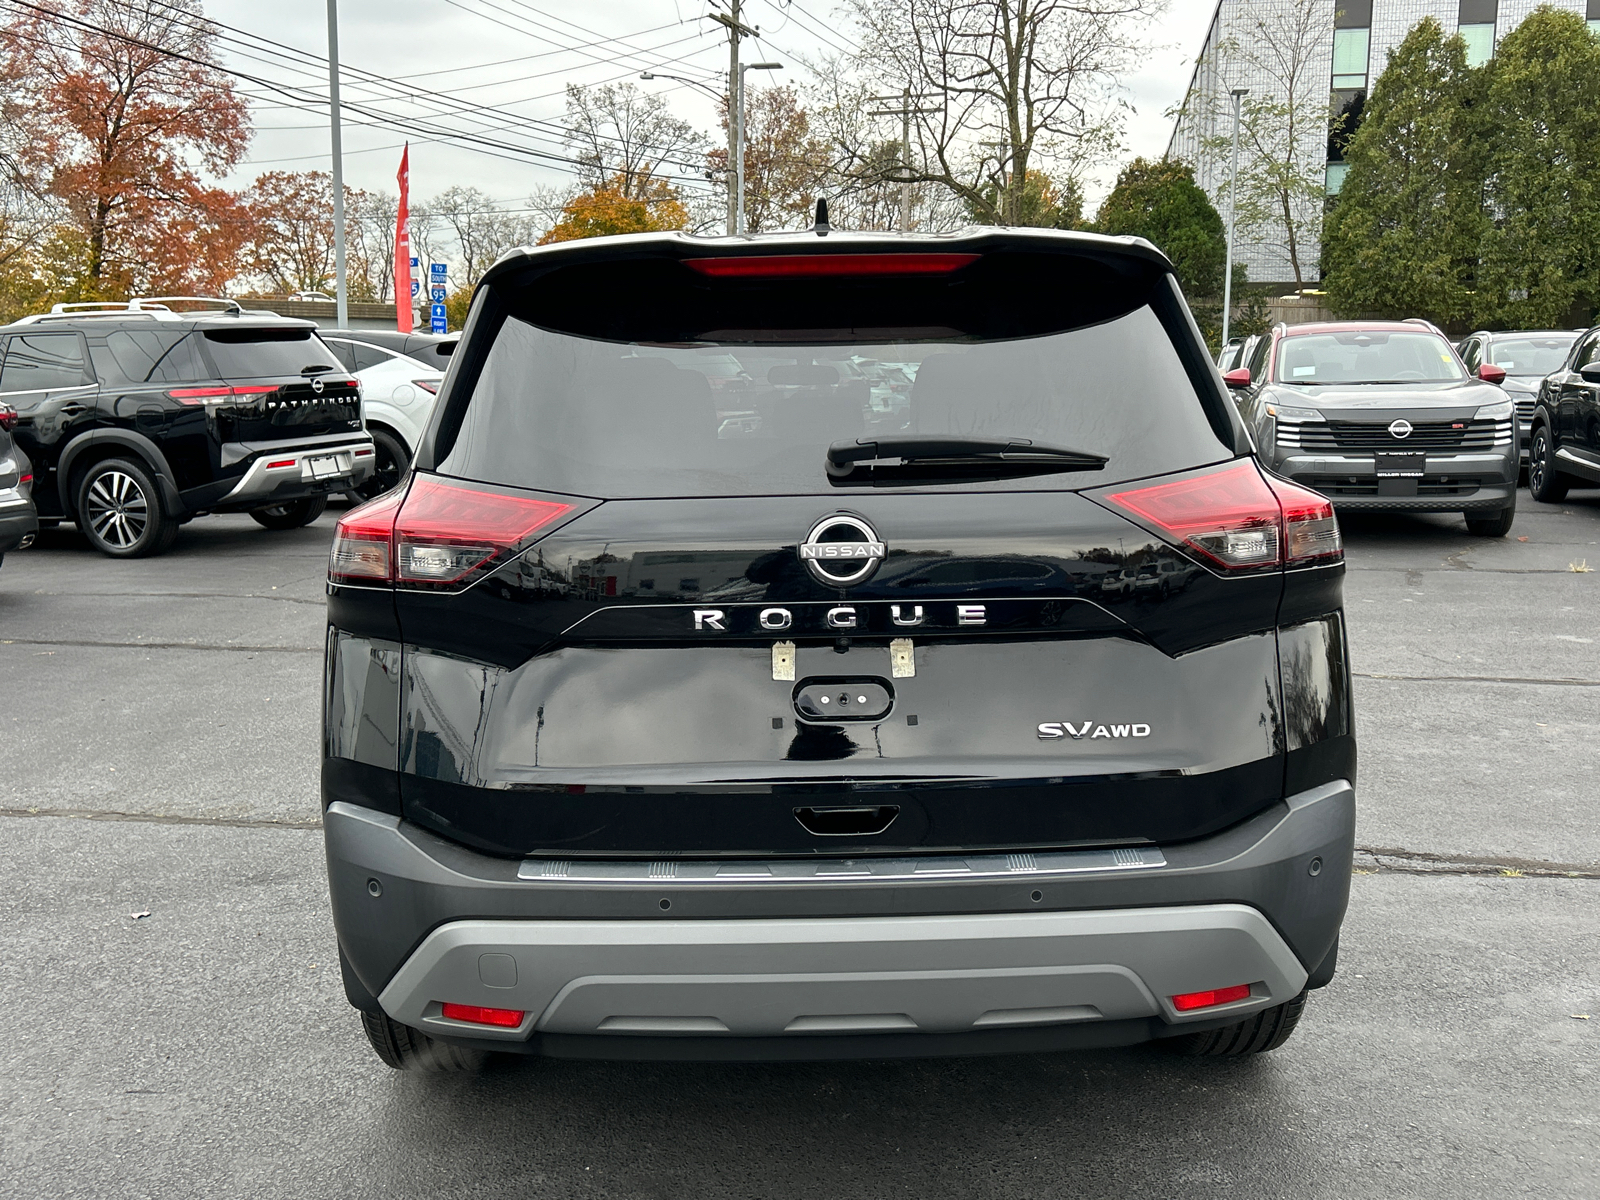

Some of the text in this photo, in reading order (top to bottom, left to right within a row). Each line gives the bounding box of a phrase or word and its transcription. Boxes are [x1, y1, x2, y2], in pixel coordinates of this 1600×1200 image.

[411, 284, 418, 294] 5
[433, 291, 445, 300] 95
[267, 396, 358, 409] PATHFINDER
[801, 544, 884, 558] NISSAN
[692, 604, 988, 630] ROGUE
[1037, 720, 1152, 740] SV AWD
